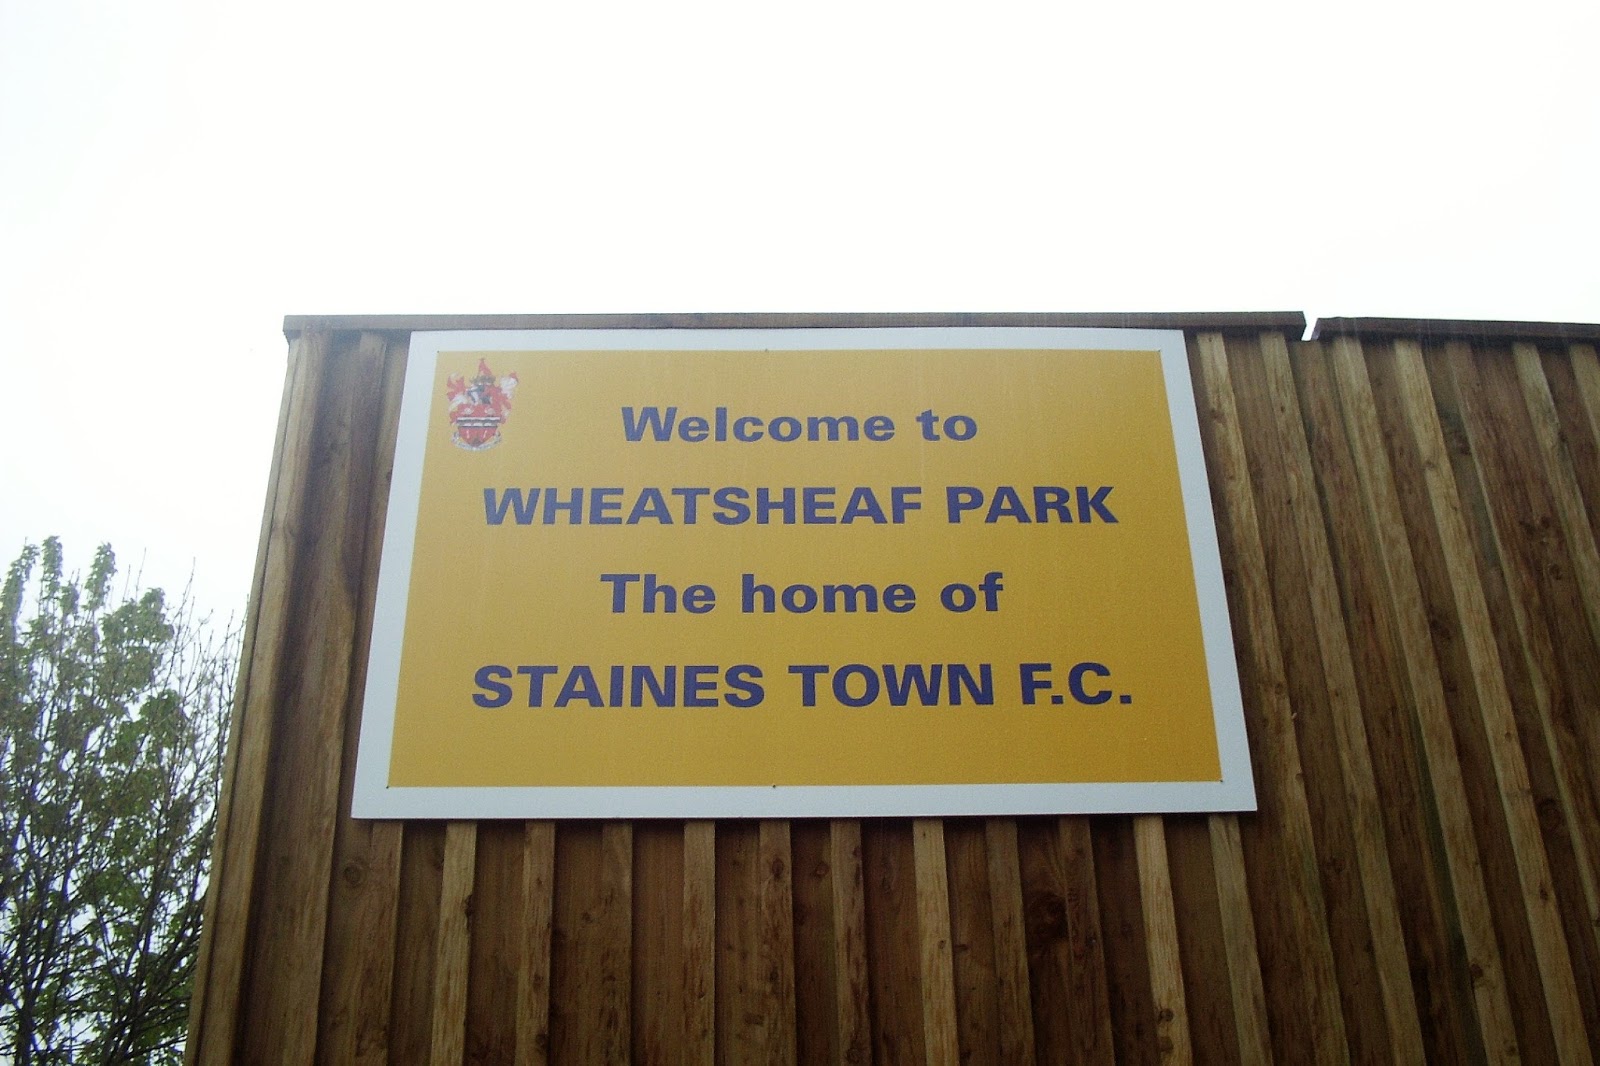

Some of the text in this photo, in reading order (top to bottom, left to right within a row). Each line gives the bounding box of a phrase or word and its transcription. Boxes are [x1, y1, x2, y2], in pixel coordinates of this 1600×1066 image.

[621, 405, 977, 443] Welcome to
[483, 485, 1117, 526] WHEATSHEAF PARK
[600, 572, 1004, 614] The home of
[472, 662, 1132, 709] STAINES TOWN F.C.
